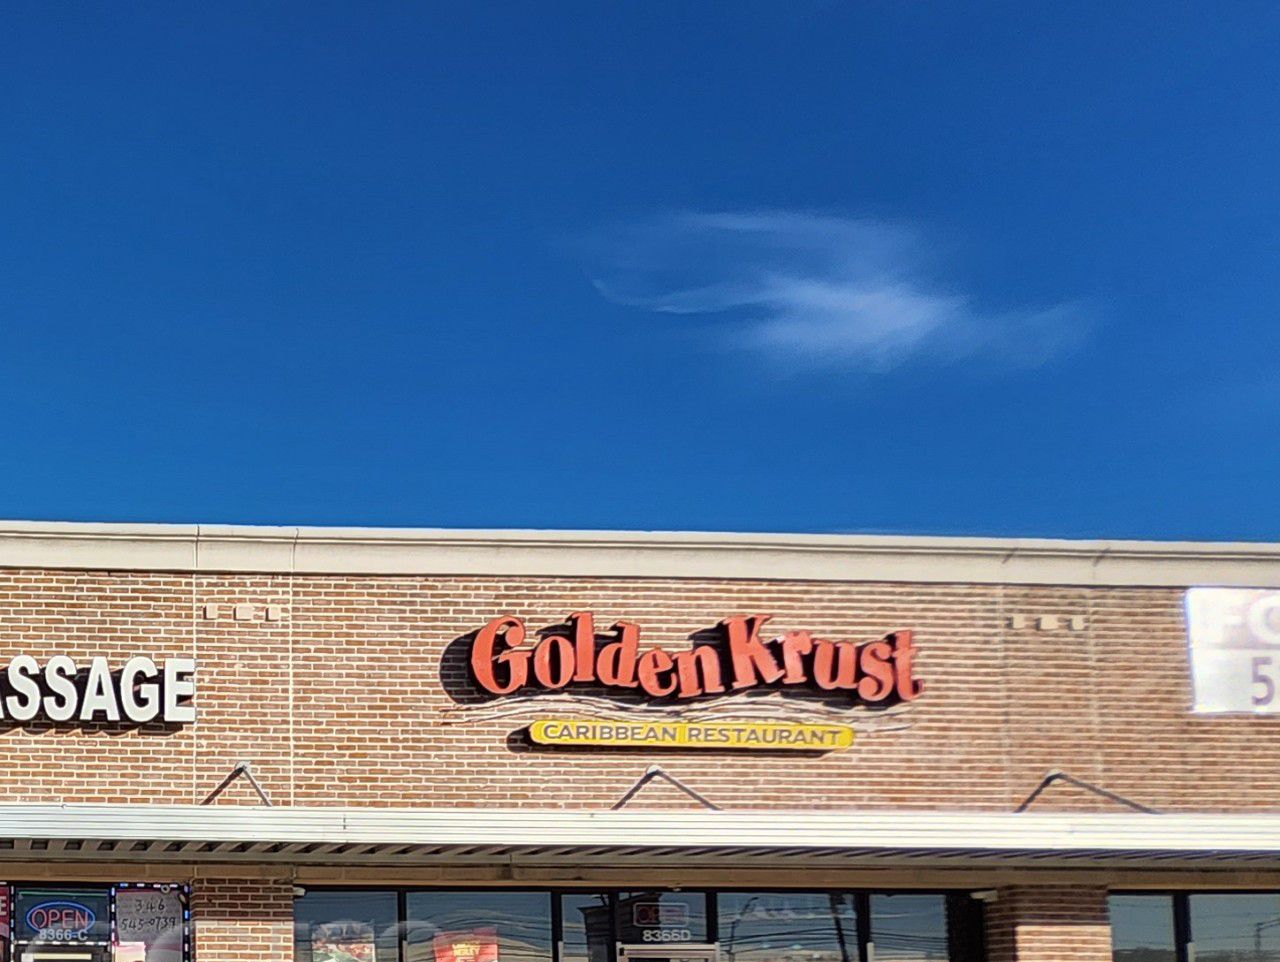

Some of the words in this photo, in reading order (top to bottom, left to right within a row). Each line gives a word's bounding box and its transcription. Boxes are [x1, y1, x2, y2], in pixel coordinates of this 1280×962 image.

[472, 612, 725, 698] Golden
[723, 614, 924, 700] Krust
[543, 724, 677, 743] CARIBBEAN
[687, 726, 841, 747] RESTAURANT
[135, 898, 165, 912] 346
[31, 909, 89, 928] OPEN
[39, 928, 89, 941] 8366-C
